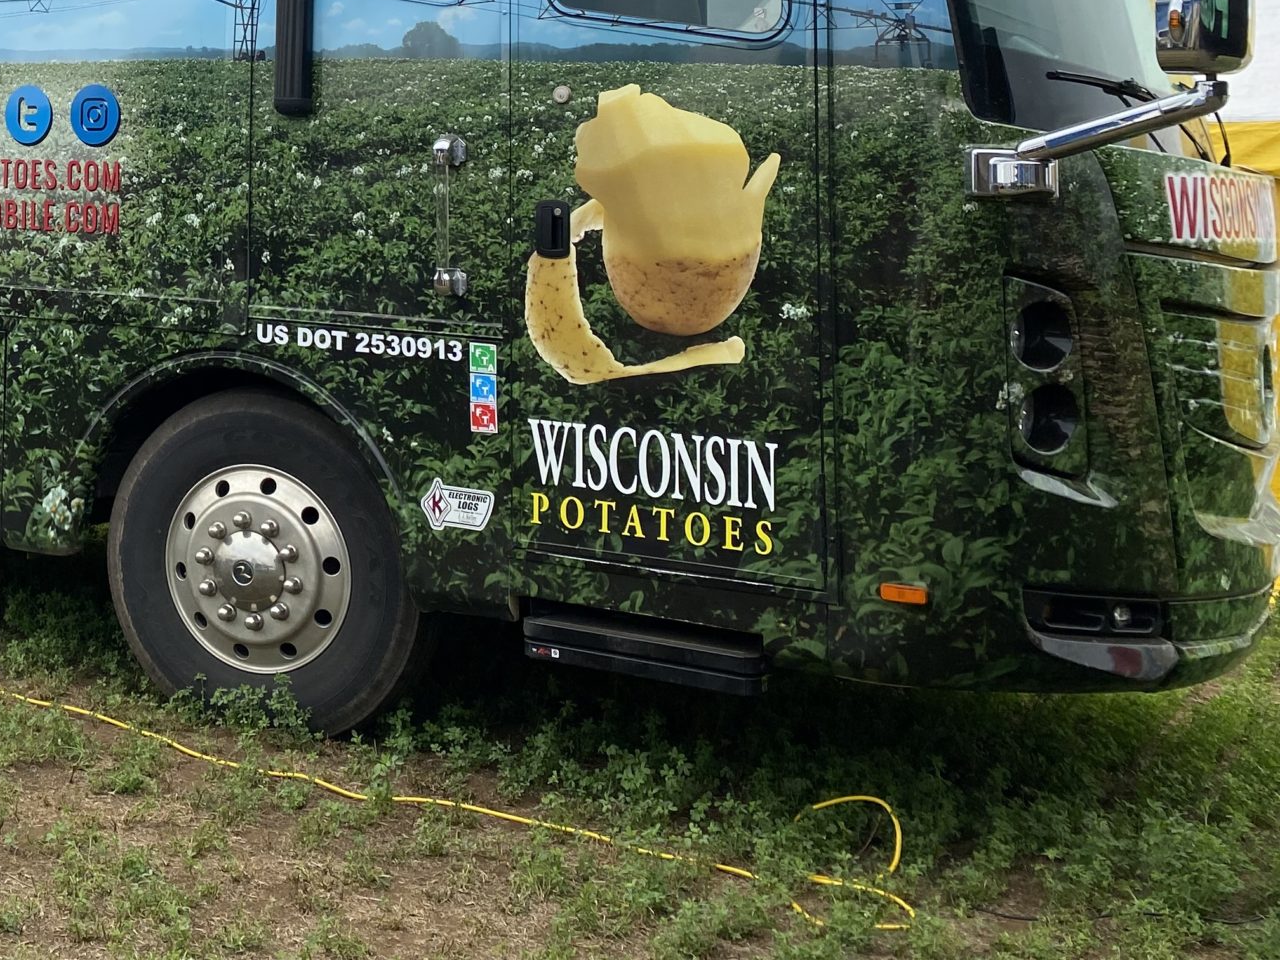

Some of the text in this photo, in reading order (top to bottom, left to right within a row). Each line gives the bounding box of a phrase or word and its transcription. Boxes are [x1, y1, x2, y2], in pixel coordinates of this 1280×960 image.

[1167, 175, 1268, 240] WISCONS
[256, 322, 464, 362] US DOT 2530913
[527, 418, 778, 512] WISCONSIN
[448, 491, 488, 503] ELECTRONIC
[457, 500, 480, 512] LOGS
[530, 490, 774, 557] POTATOES
